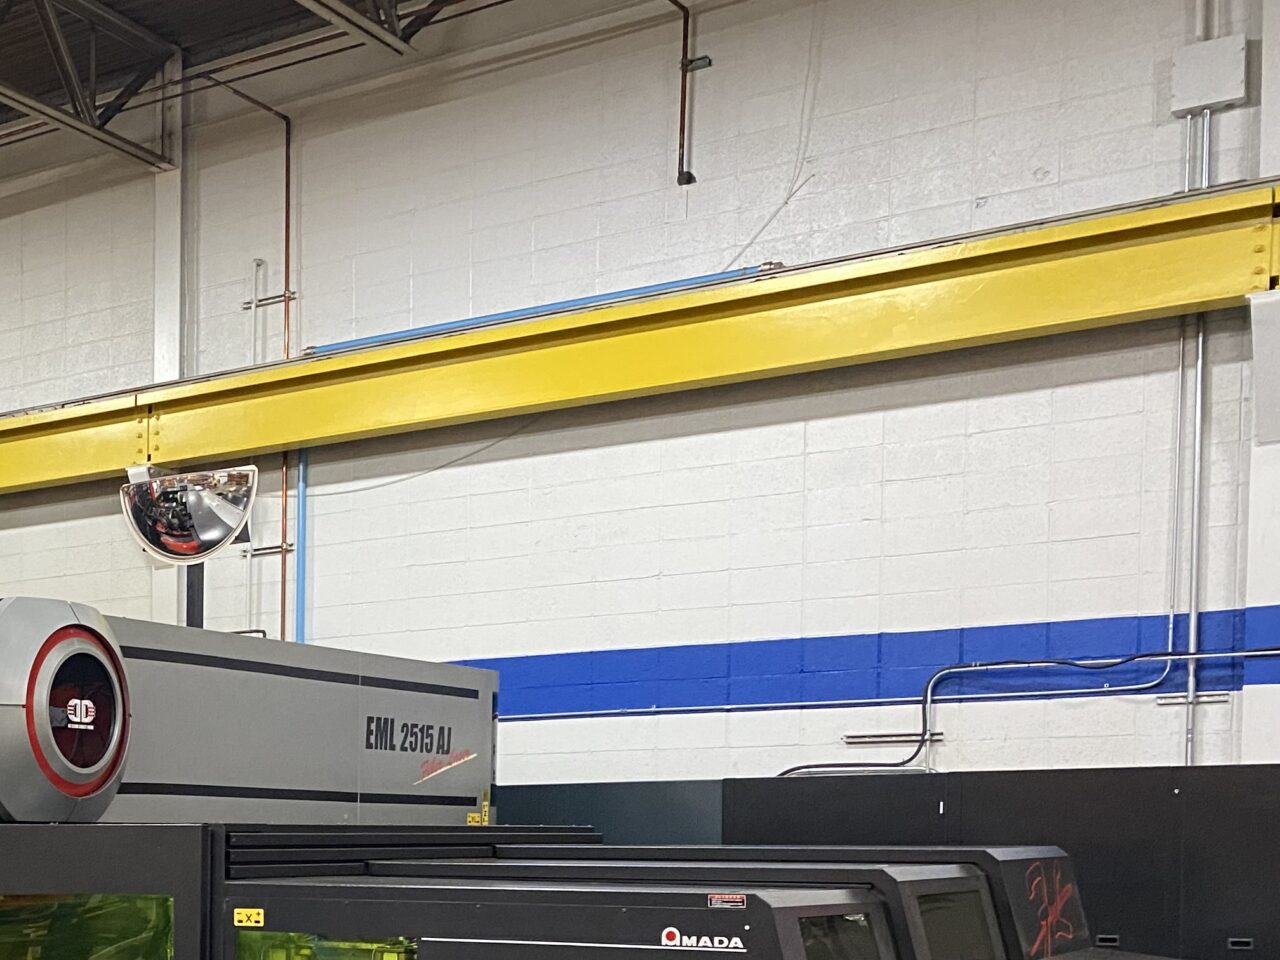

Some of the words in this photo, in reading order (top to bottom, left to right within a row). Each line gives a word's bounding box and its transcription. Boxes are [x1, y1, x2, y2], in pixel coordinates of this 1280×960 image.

[365, 716, 396, 751] EML
[400, 722, 434, 753] 2515
[436, 726, 452, 755] AJ
[245, 914, 252, 922] X
[661, 927, 744, 948] AMADA
